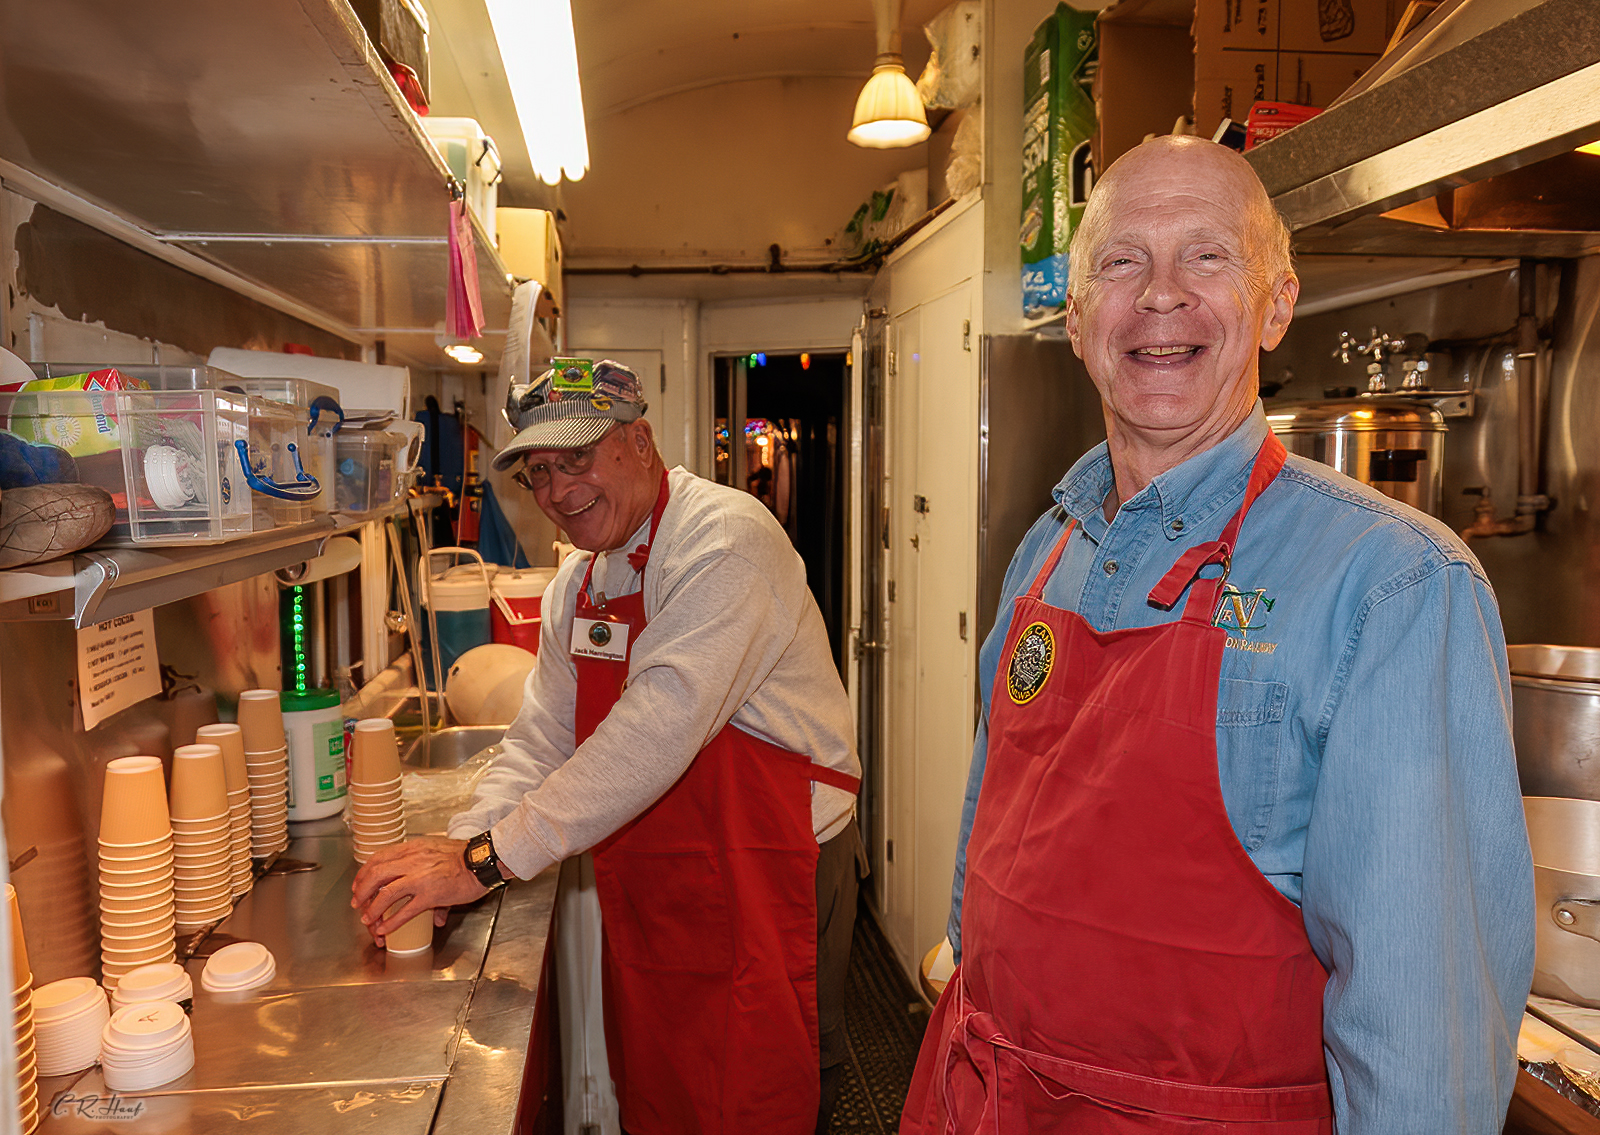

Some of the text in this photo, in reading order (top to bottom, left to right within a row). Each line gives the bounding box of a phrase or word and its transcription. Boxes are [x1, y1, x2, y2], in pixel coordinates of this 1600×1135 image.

[574, 647, 624, 660] Jack Harrington
[1034, 626, 1052, 673] CANYON
